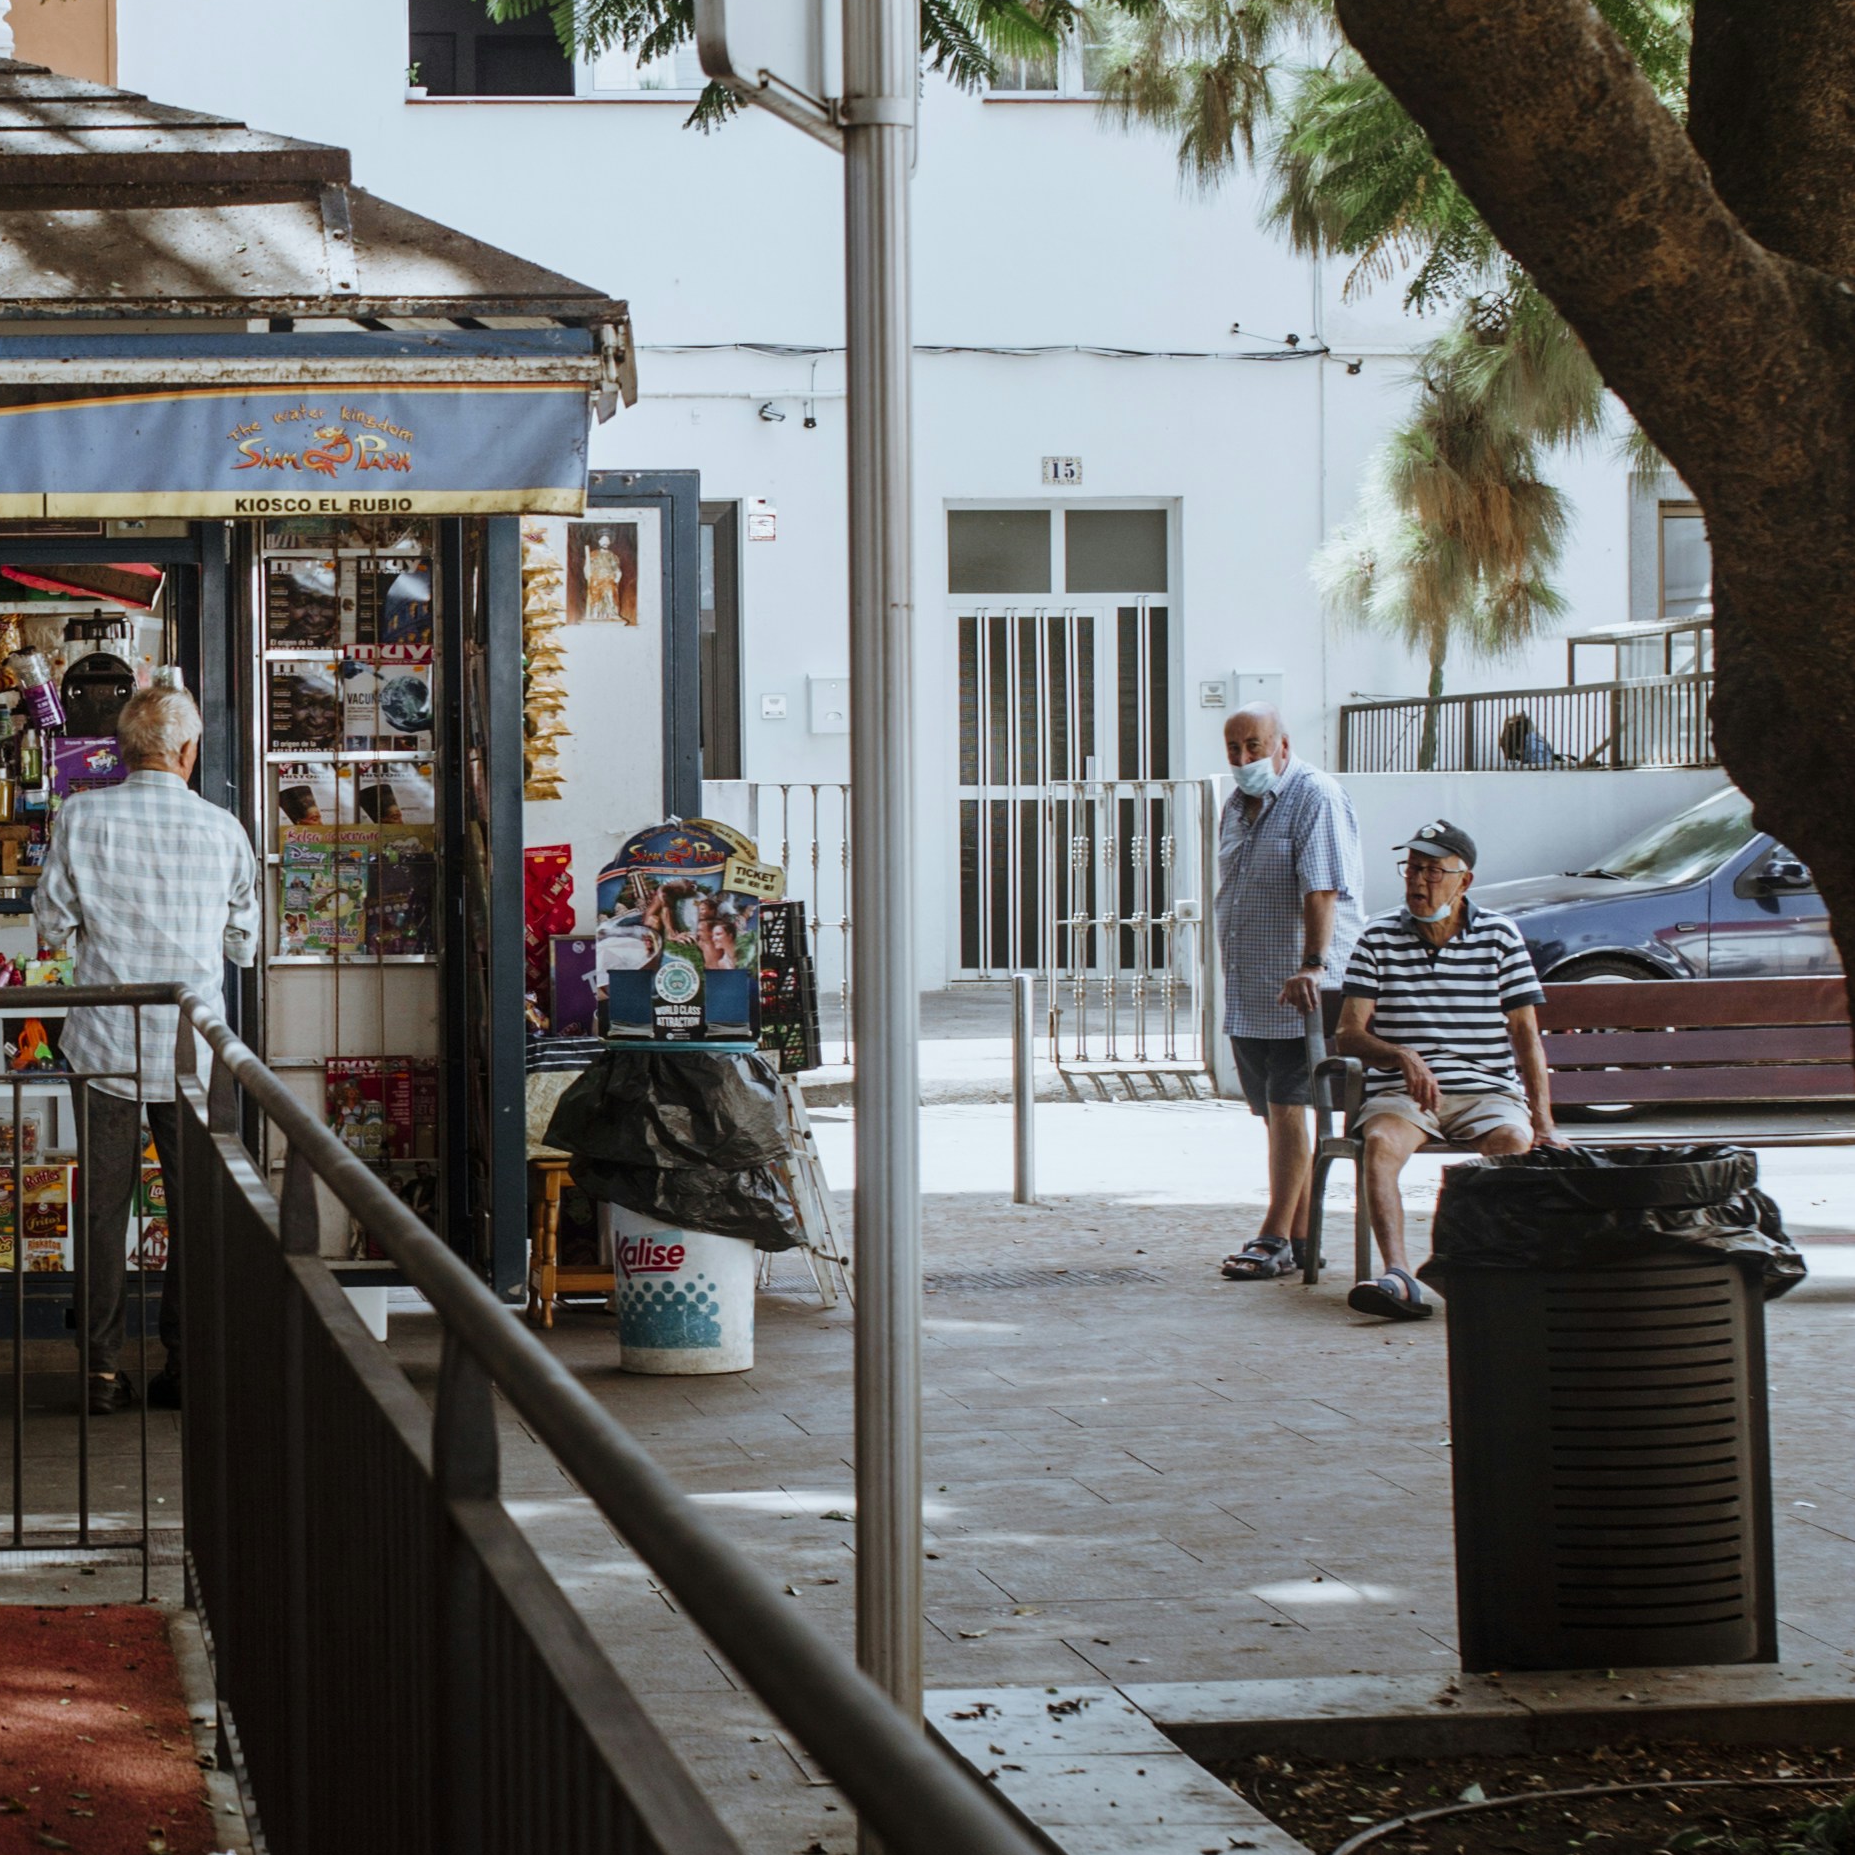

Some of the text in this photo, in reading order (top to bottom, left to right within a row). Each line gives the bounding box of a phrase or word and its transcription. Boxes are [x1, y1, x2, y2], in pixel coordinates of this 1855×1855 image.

[340, 406, 414, 441] kingdom
[1052, 462, 1075, 479] 15
[235, 497, 412, 512] KIOSCO EL RUBIO
[346, 645, 431, 660] muy
[289, 845, 326, 864] Disney
[735, 866, 777, 883] TICKET
[655, 1006, 701, 1016] WORLD CLASS
[656, 1016, 700, 1027] ATTRACTION
[615, 1231, 686, 1280] Kalise
